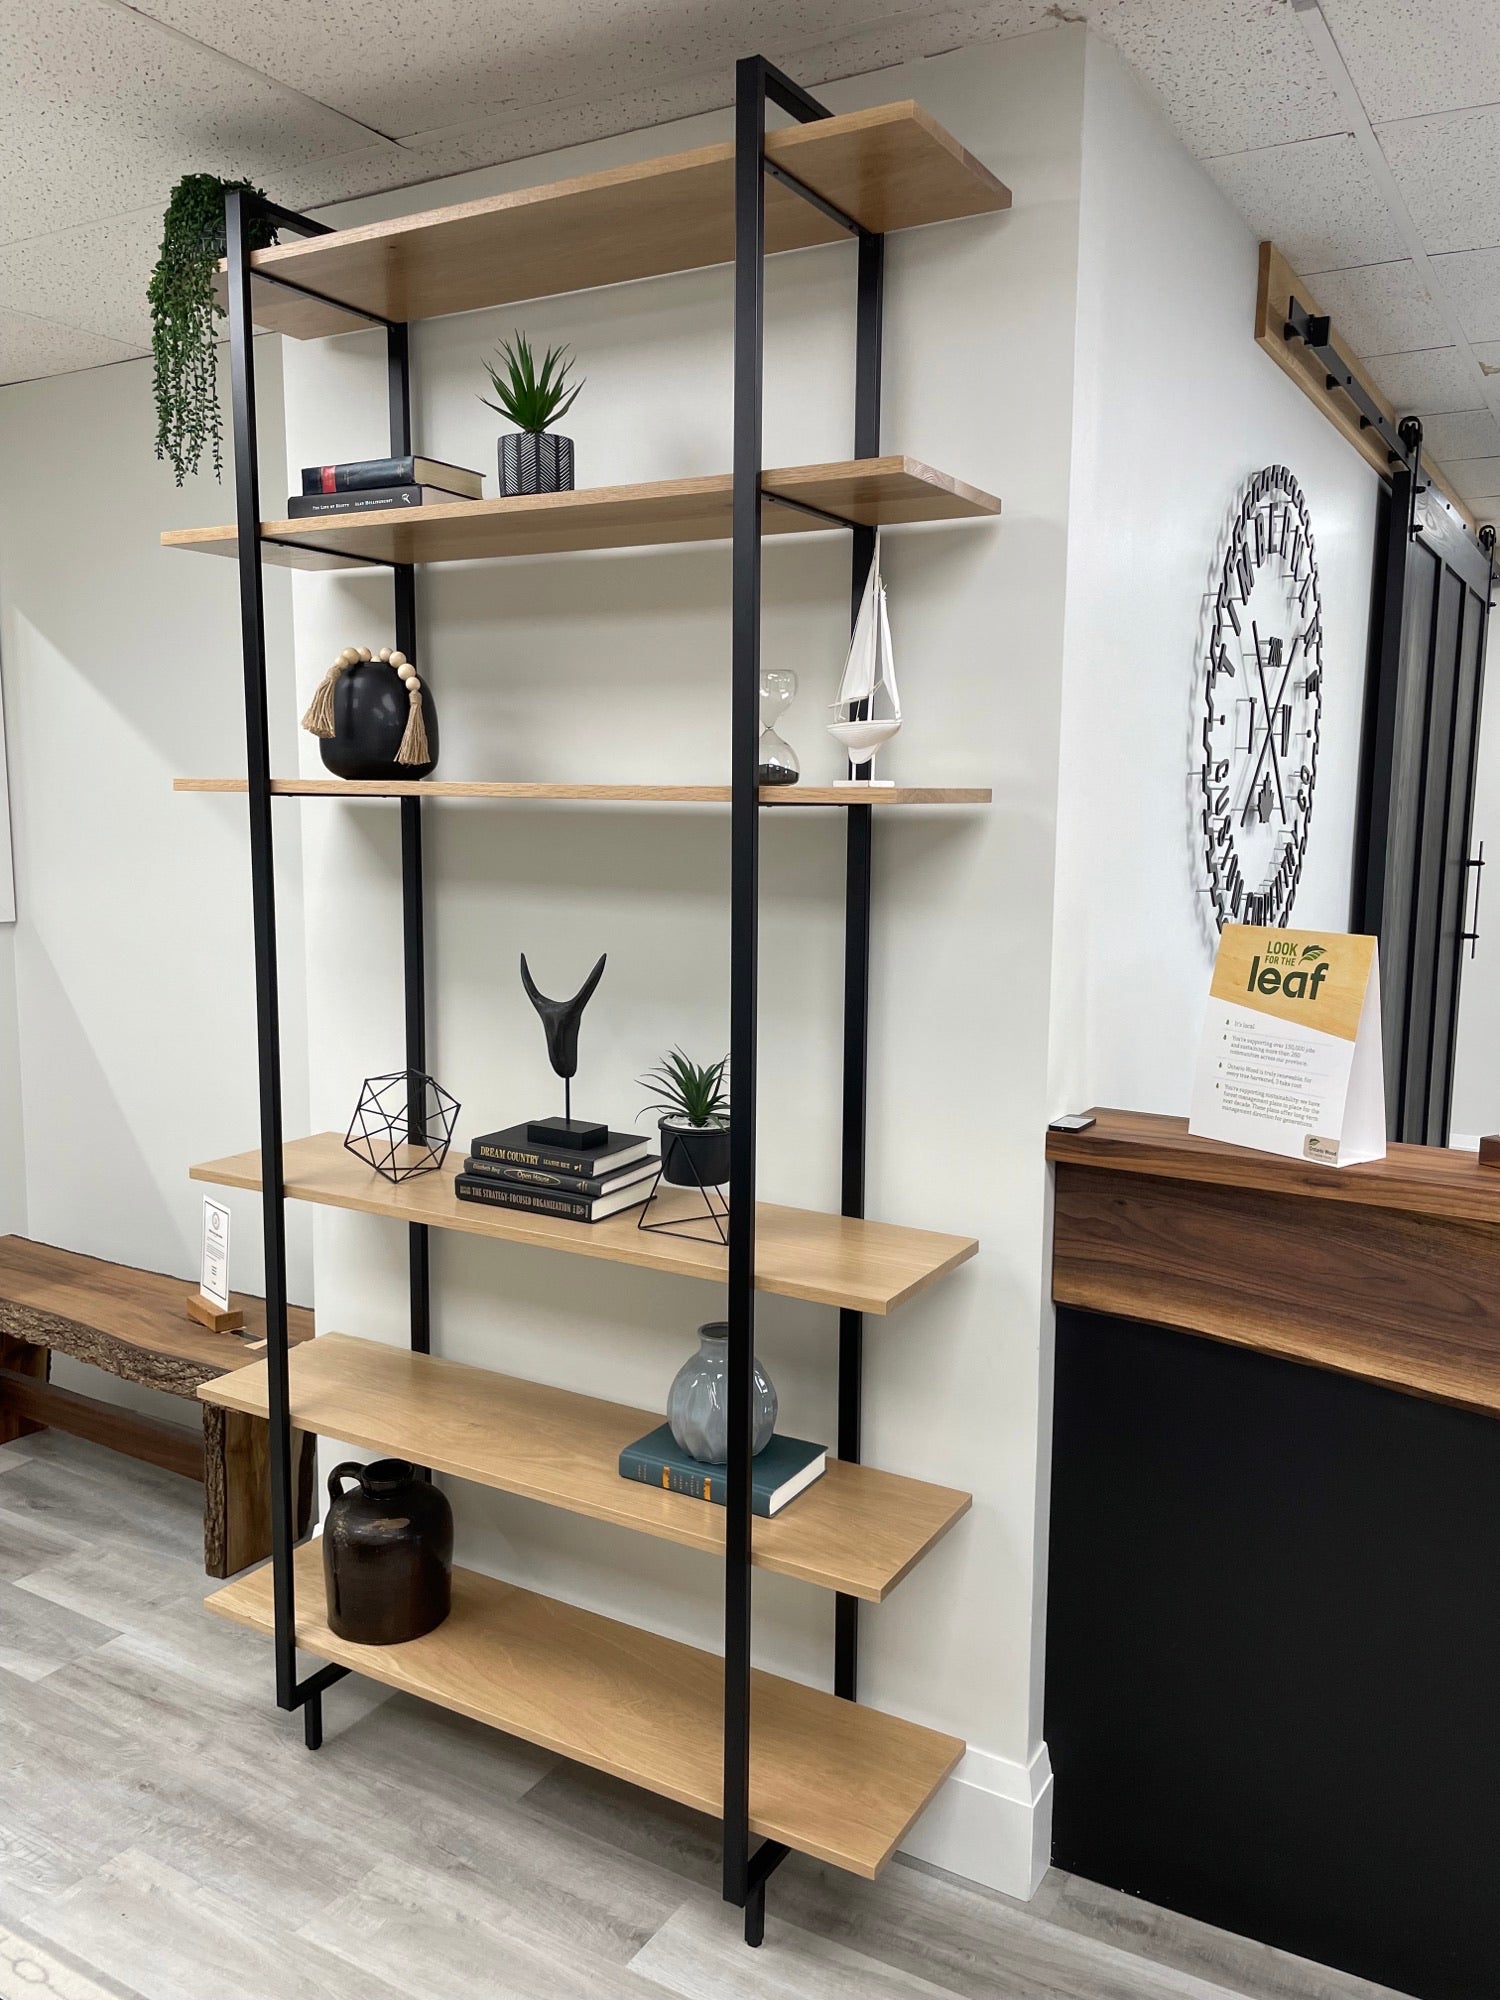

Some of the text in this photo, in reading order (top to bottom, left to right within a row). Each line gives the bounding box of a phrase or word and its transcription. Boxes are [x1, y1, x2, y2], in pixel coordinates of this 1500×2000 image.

[1267, 941, 1298, 956] LOOK
[1265, 955, 1296, 966] FOR THE
[1248, 956, 1329, 1000] leaf
[480, 1146, 506, 1160] DREAM
[506, 1150, 540, 1165] COUNTRY
[517, 1172, 532, 1180] Open
[532, 1174, 550, 1183] House
[472, 1187, 482, 1196] THE
[483, 1189, 532, 1206] STRATEGY-FOCUSED
